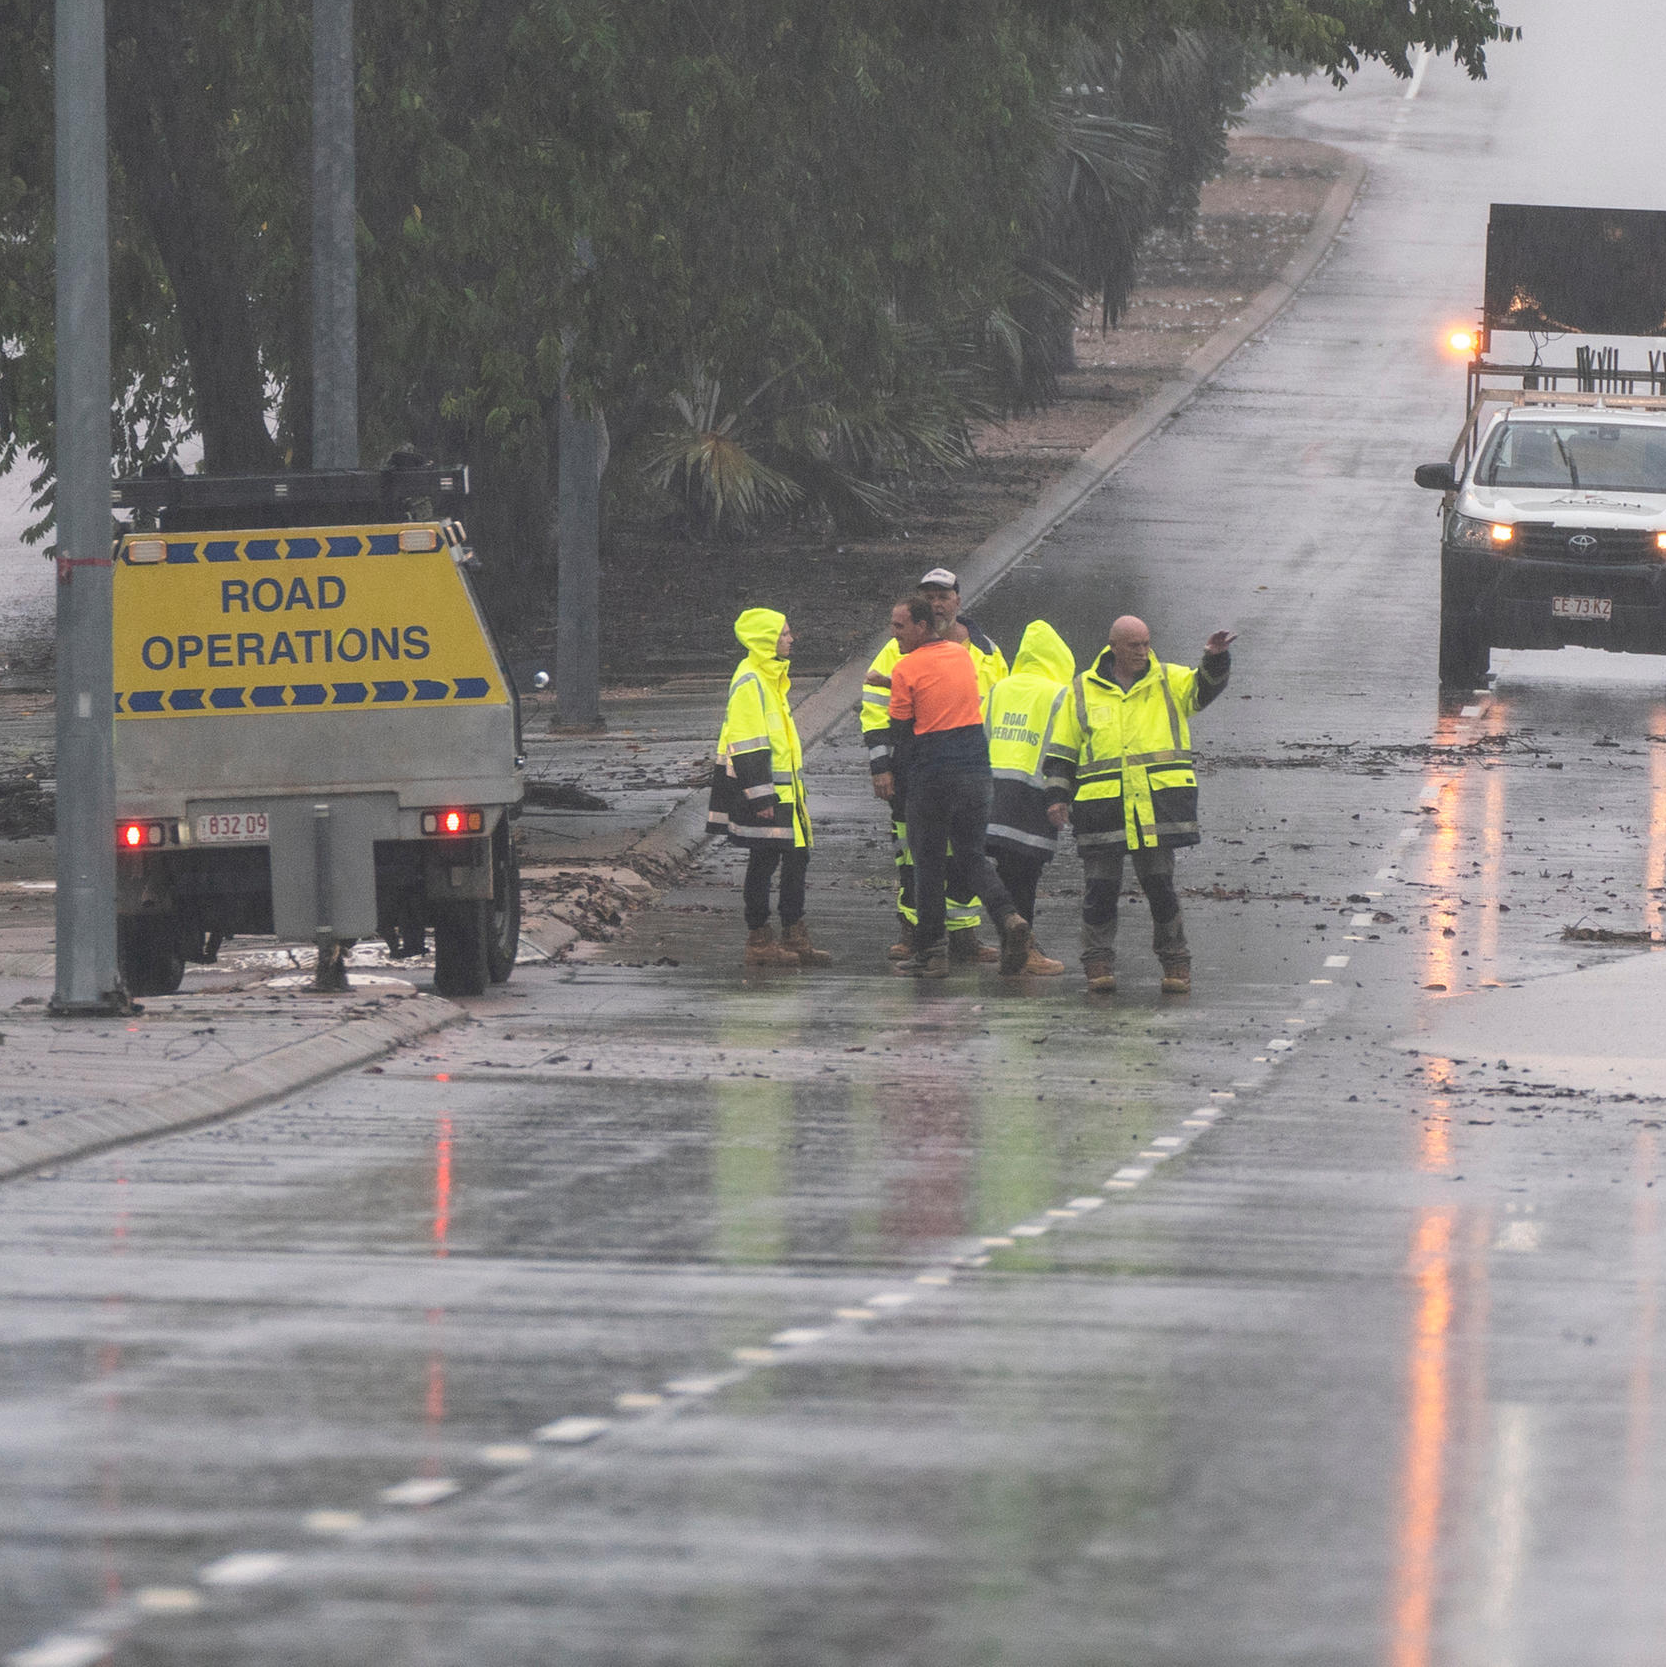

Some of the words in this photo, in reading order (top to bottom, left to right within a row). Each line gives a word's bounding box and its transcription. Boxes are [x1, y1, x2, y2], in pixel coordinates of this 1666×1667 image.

[221, 576, 346, 612] ROAD
[142, 626, 430, 670] OPERATIONS
[1002, 712, 1028, 726] ROAD
[246, 815, 267, 834] 09
